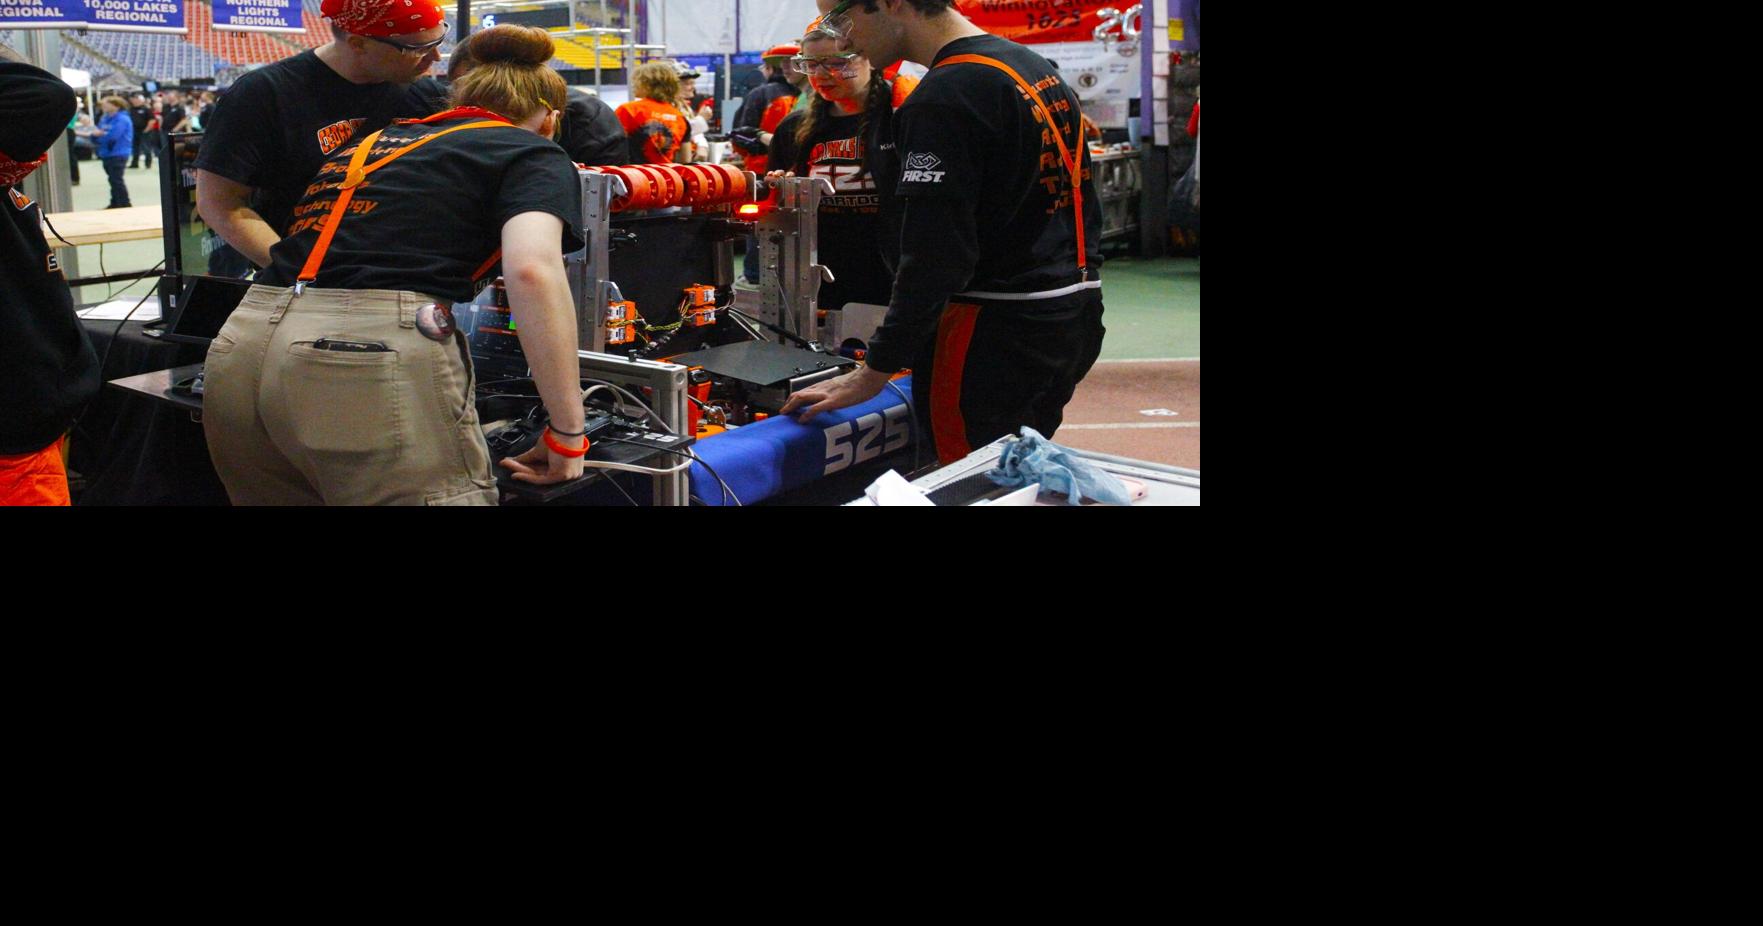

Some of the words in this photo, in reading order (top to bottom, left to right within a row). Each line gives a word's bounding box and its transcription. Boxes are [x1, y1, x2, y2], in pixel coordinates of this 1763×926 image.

[0, 7, 64, 17] EGIONAL
[84, 0, 130, 10] 10,000
[134, 3, 177, 13] LAKES
[238, 7, 279, 16] LIGHTS
[95, 10, 167, 23] REGIONAL
[230, 16, 288, 26] REGIONAL
[1027, 9, 1081, 30] 1625
[902, 170, 946, 183] FIRST
[823, 402, 910, 476] 525
